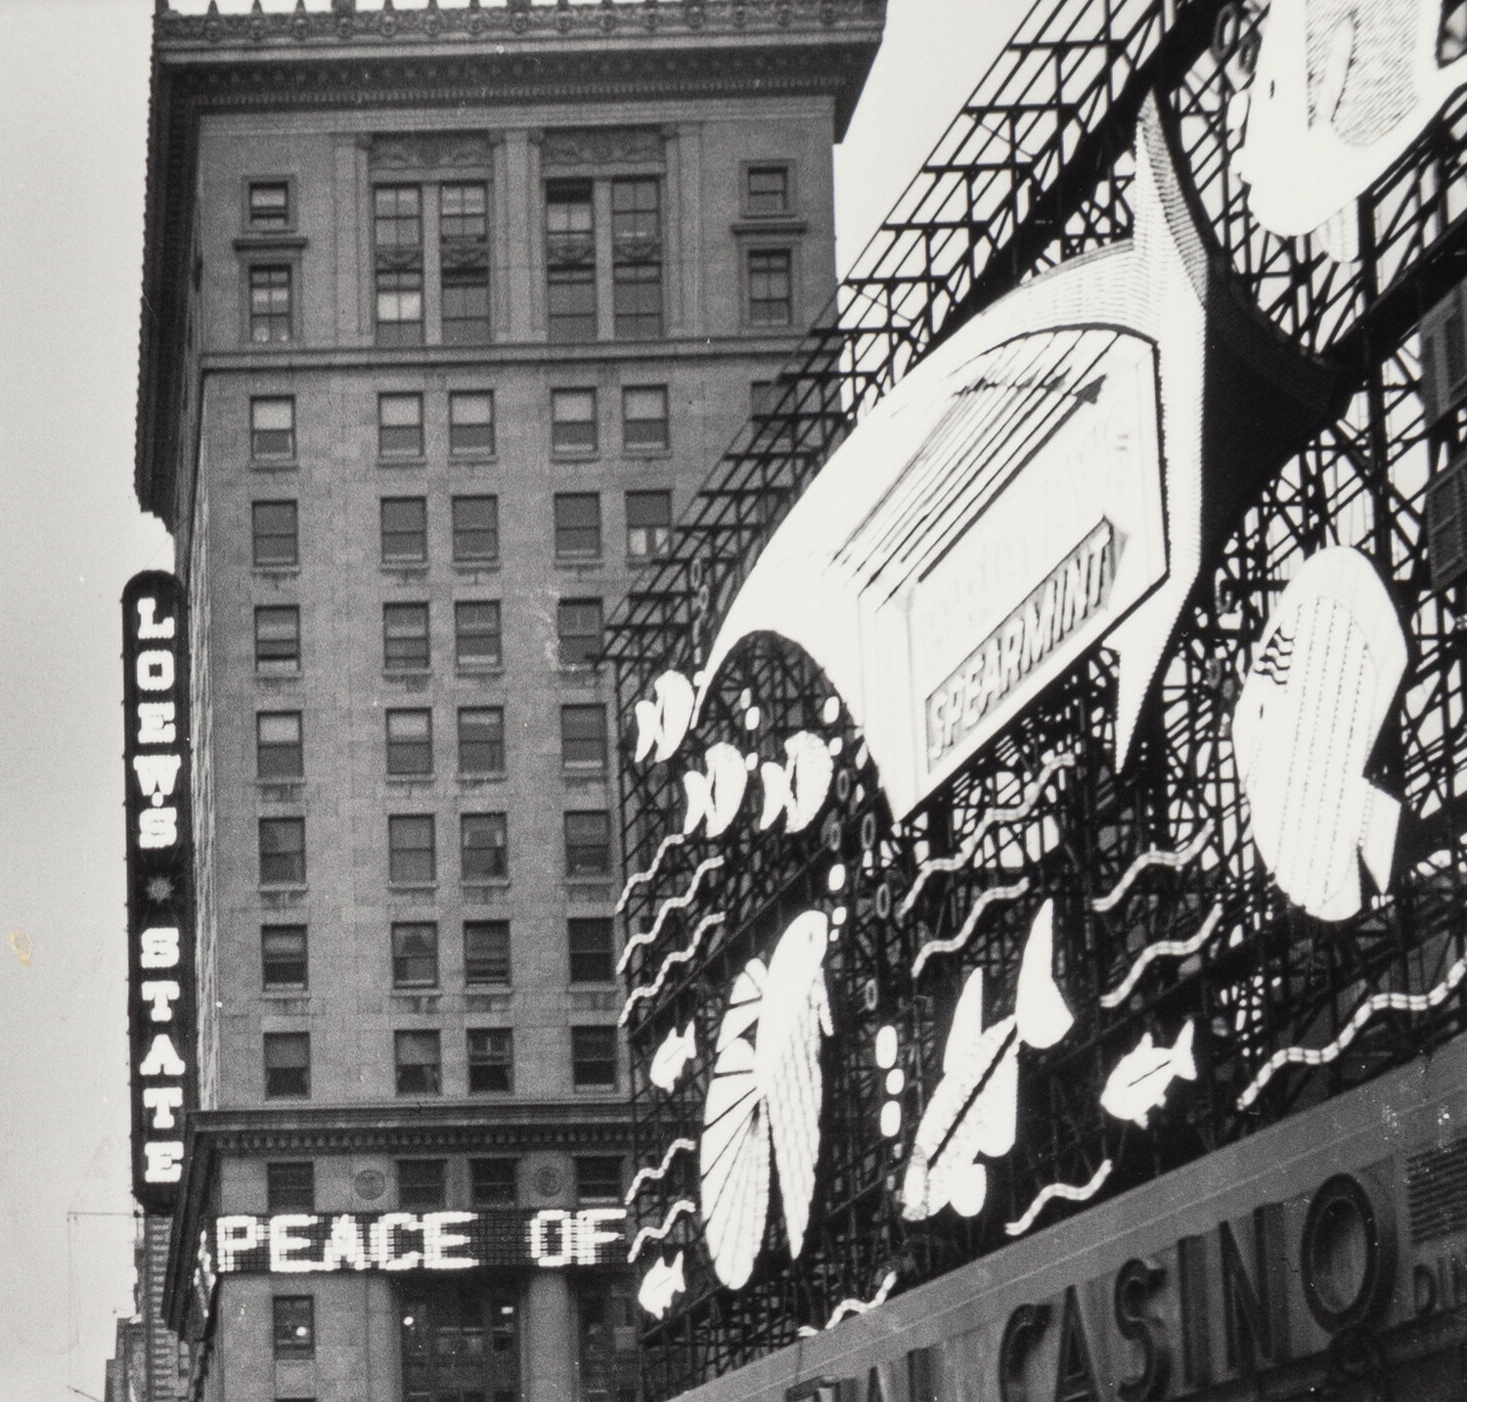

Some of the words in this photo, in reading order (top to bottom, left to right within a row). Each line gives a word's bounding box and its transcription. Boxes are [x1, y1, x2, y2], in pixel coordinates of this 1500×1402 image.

[133, 597, 182, 849] LOEW'S
[930, 525, 1111, 760] SPEARMINT
[139, 926, 186, 1184] STATE
[216, 1210, 478, 1274] PEACE
[529, 1208, 627, 1267] OF
